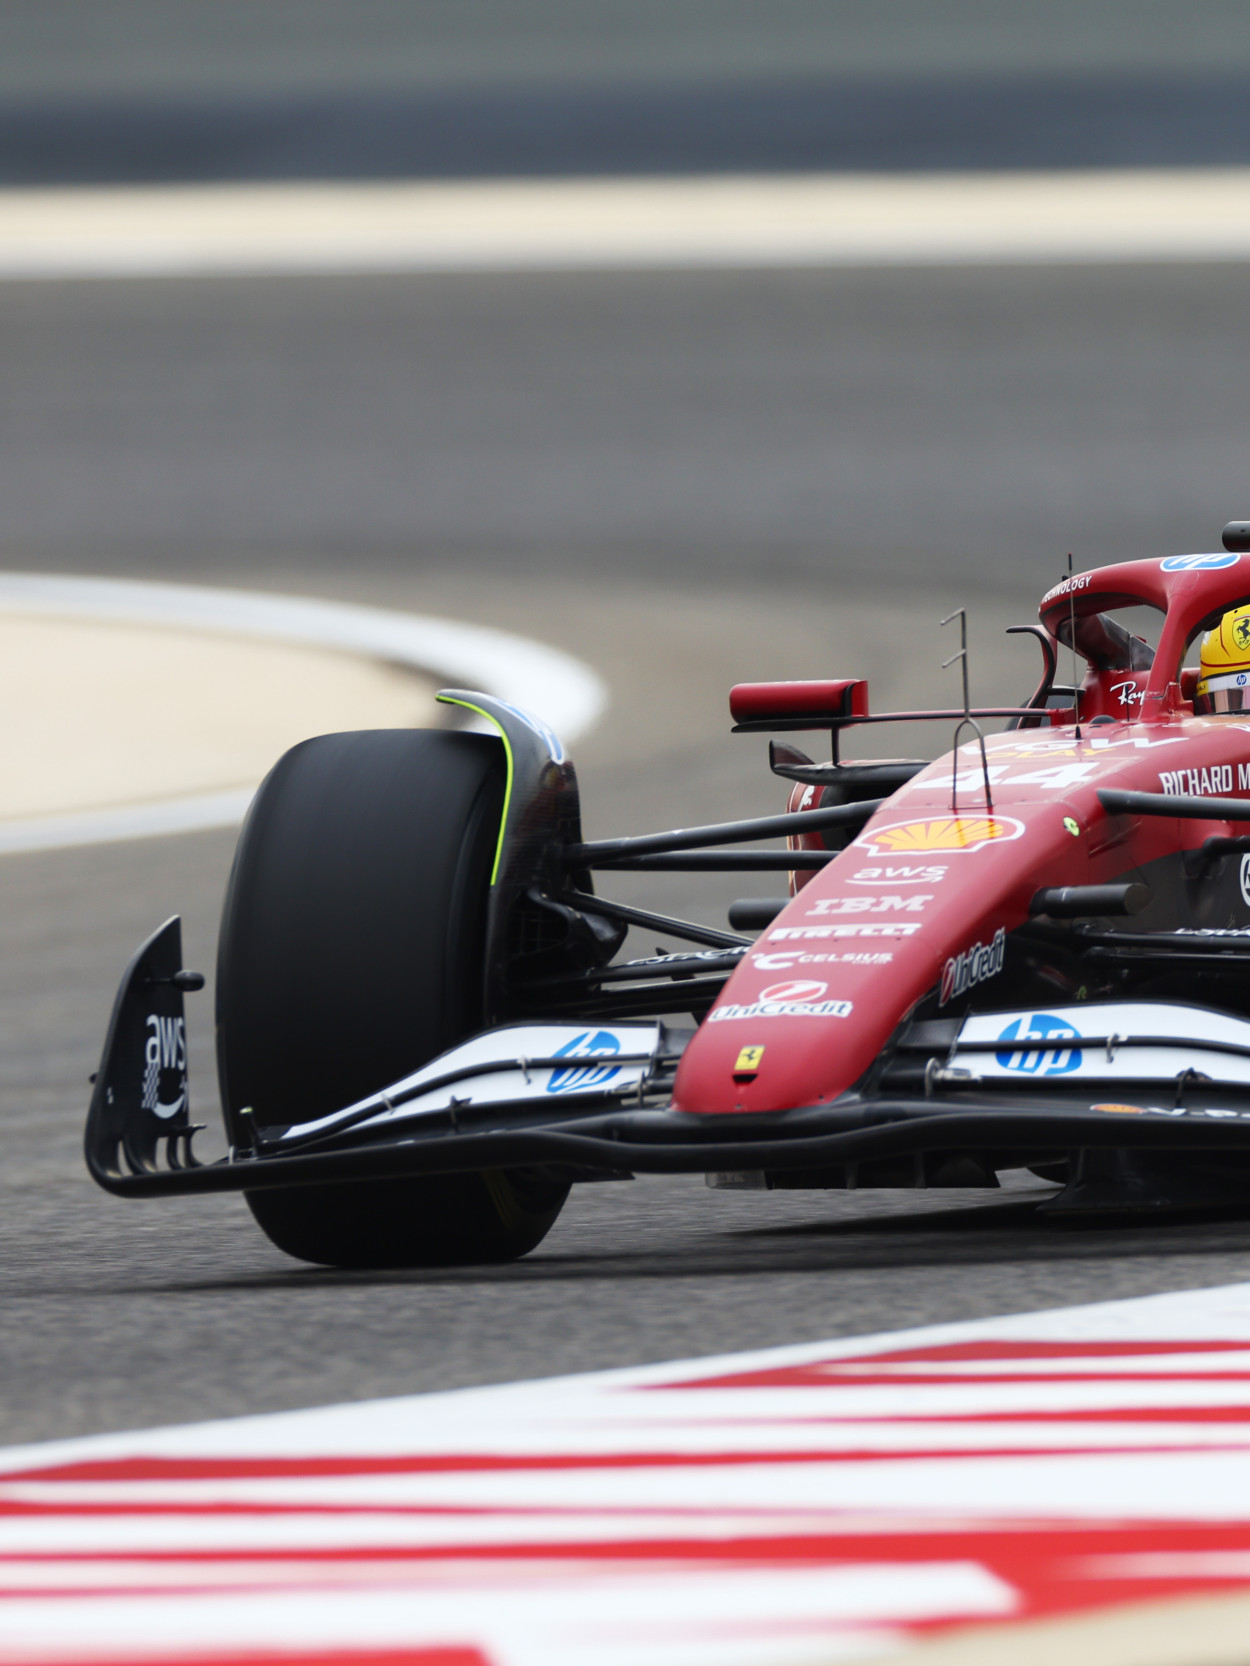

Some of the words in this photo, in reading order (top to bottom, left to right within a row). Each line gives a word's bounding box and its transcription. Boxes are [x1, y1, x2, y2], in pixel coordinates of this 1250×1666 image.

[1236, 674, 1247, 686] hp
[911, 762, 1101, 793] 44
[1158, 766, 1233, 796] RICHARD
[852, 866, 949, 880] aws
[804, 895, 935, 916] IBM
[767, 923, 922, 941] PIRELLI
[798, 953, 893, 964] CELSIUS
[950, 929, 1005, 997] UniCredit
[710, 1001, 850, 1021] UniCredit
[146, 1015, 185, 1070] aws
[1005, 1016, 1076, 1075] hp
[550, 1030, 618, 1093] hp
